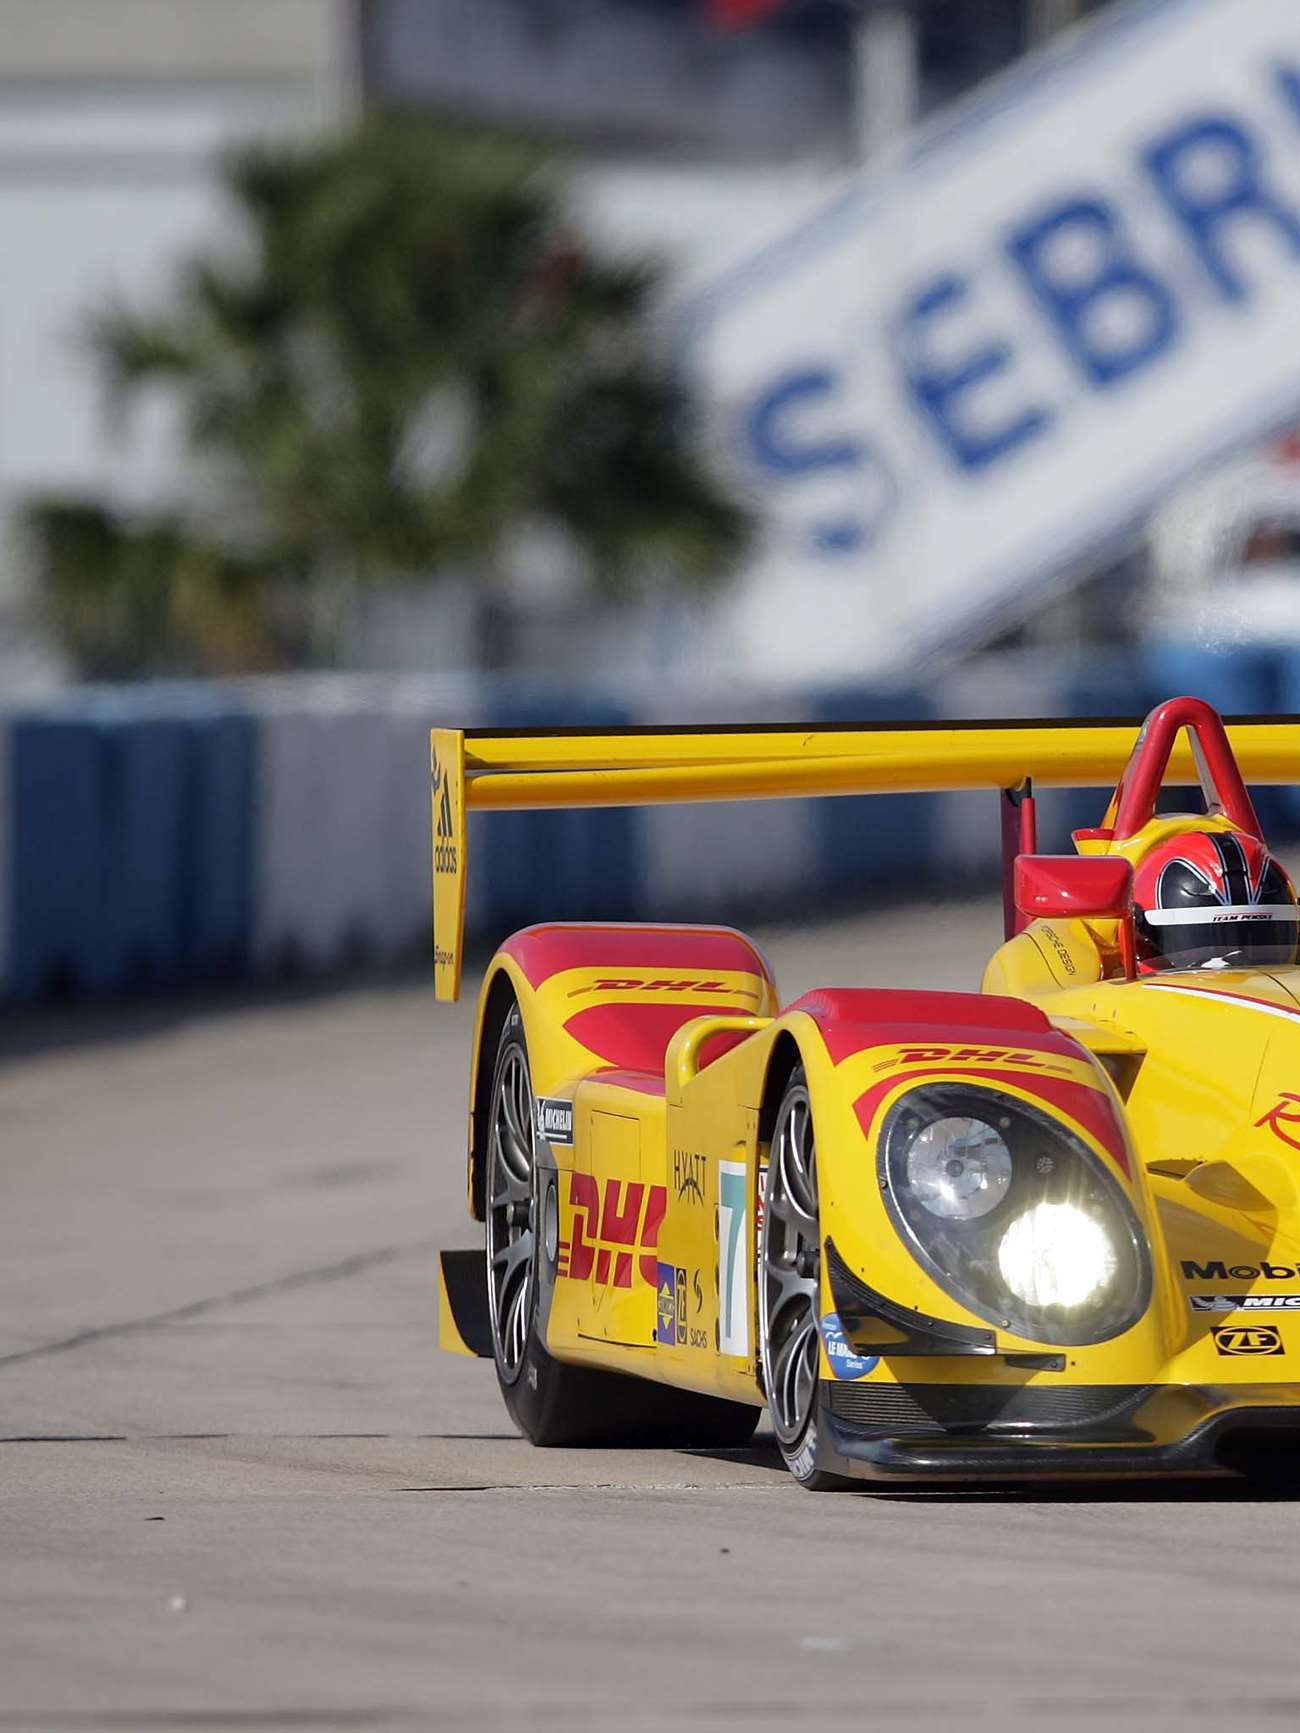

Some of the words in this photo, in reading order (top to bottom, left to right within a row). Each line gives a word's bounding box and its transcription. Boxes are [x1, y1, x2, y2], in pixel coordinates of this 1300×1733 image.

[593, 979, 735, 993] DHL
[898, 1048, 1046, 1066] DHL
[673, 1149, 706, 1200] HYATT
[569, 1171, 668, 1289] DHL
[719, 1172, 747, 1339] 7
[1221, 1331, 1272, 1350] ZF
